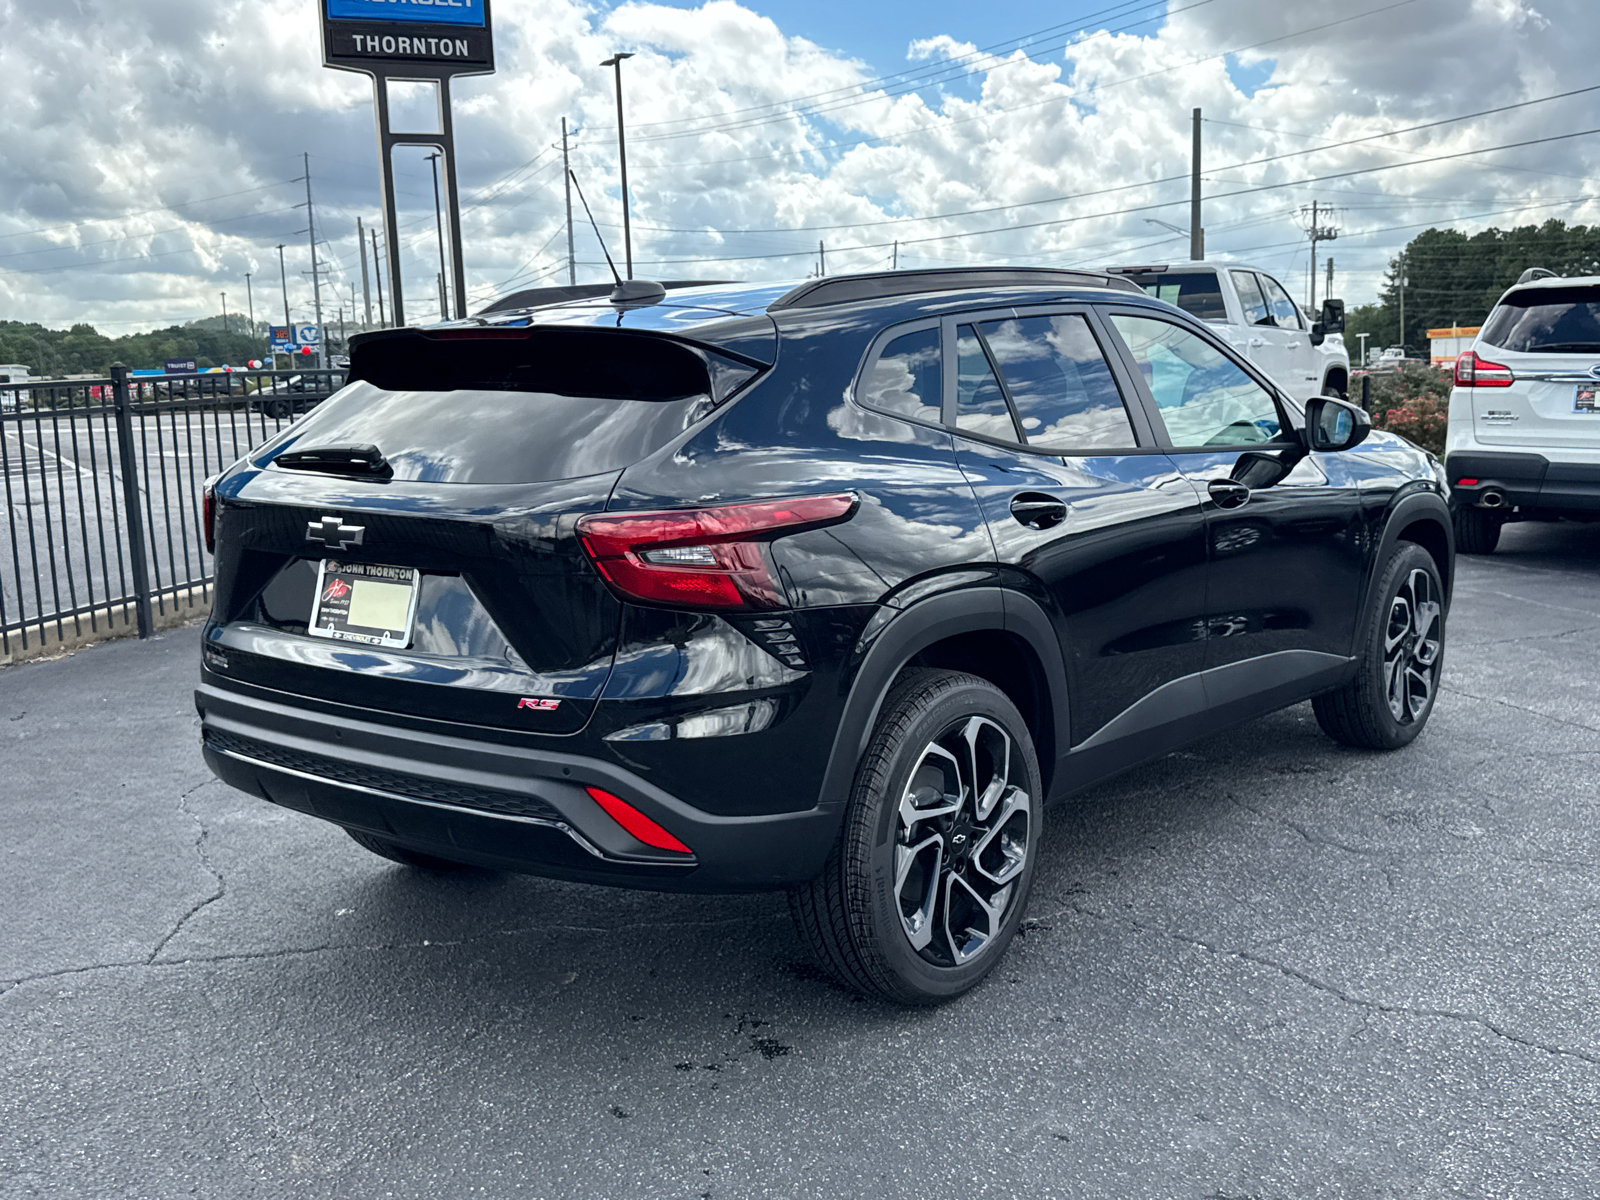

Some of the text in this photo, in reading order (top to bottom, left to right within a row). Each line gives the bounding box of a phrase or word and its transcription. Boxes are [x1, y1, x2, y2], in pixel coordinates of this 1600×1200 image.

[352, 34, 468, 57] THORNTON
[342, 564, 413, 580] JOHN THORNTON
[517, 697, 562, 711] RS
